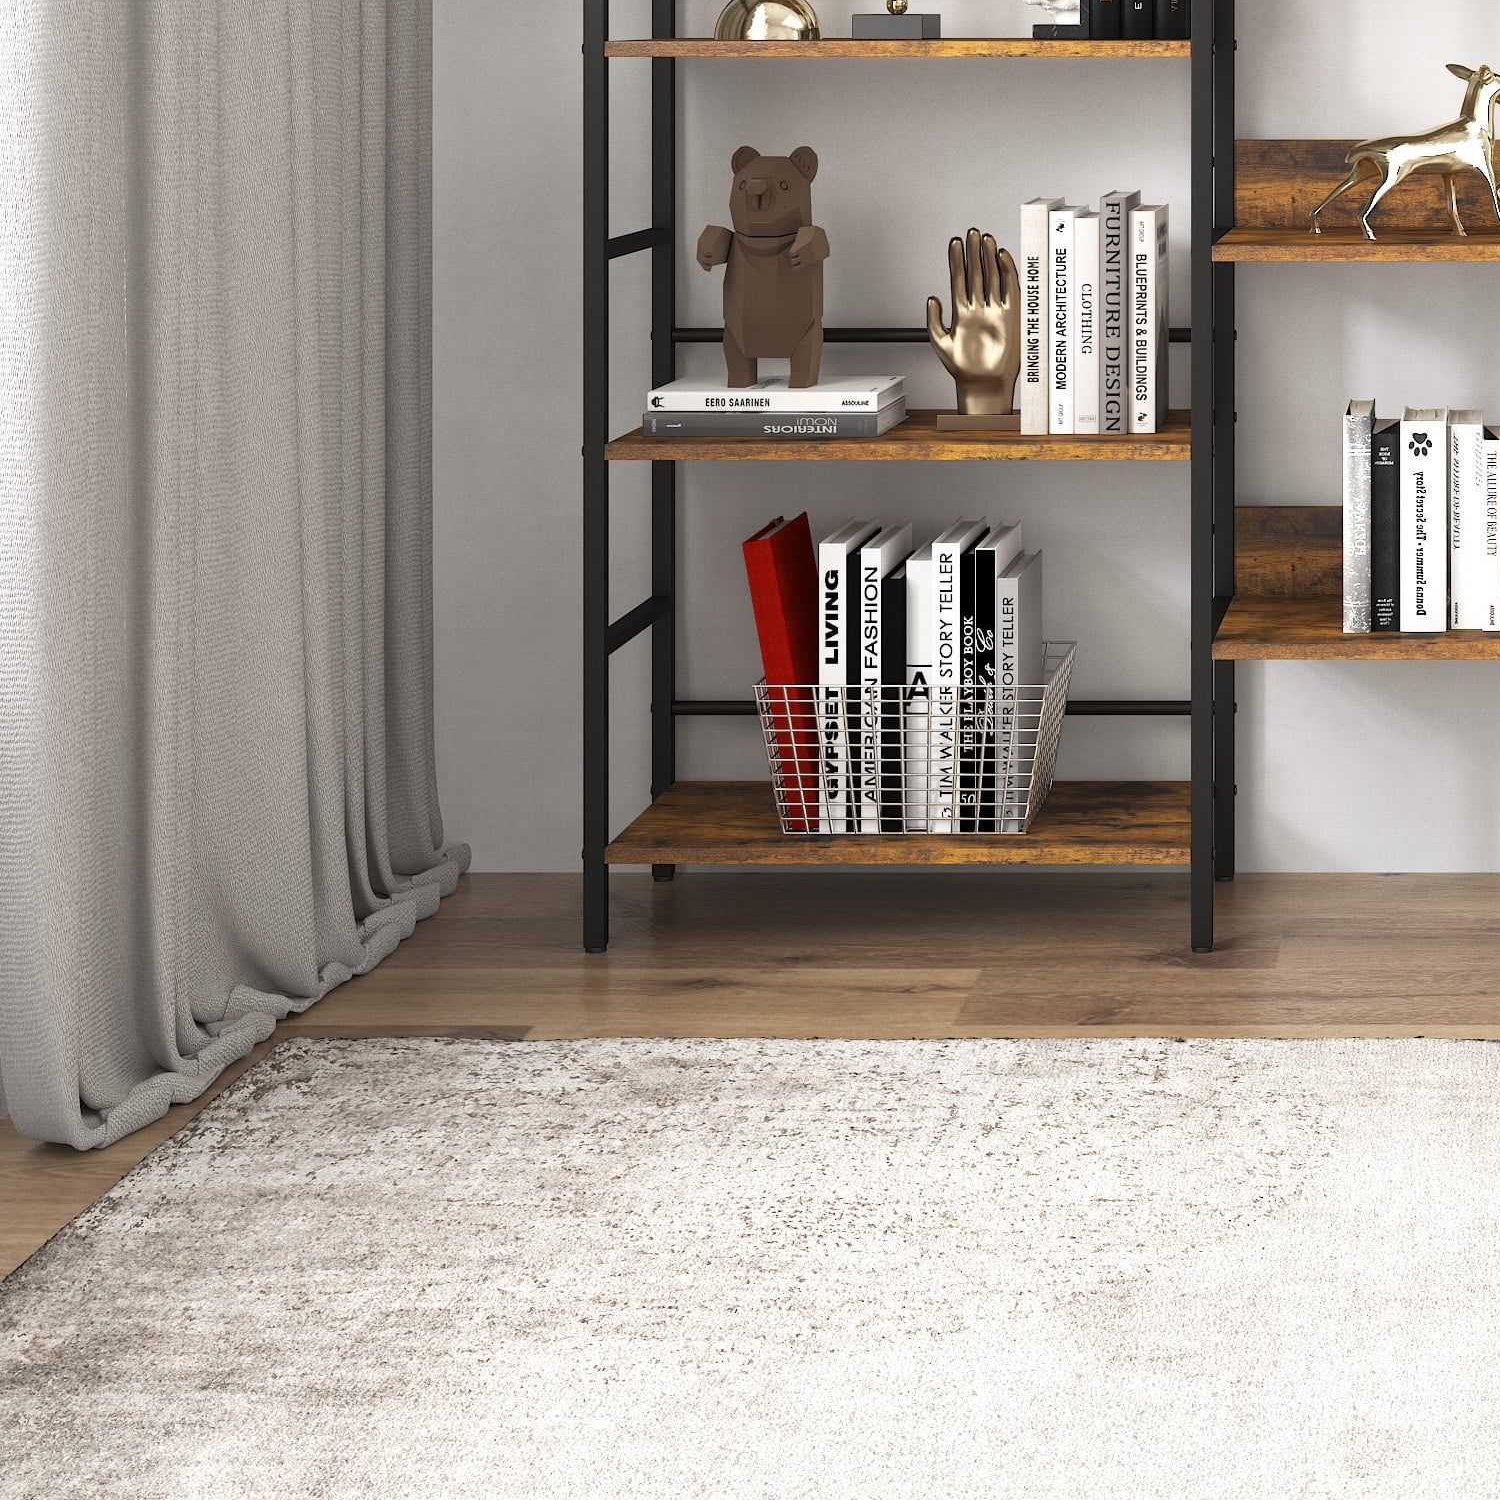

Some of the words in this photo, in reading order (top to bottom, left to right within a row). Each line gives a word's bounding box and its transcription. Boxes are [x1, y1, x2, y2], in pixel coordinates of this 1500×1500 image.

[1027, 256, 1039, 282] HOME
[1056, 249, 1066, 337] ARCHITECTURE
[1106, 202, 1120, 338] FURNITURE
[1136, 254, 1147, 324] BLUEPRINTS
[1027, 285, 1039, 315] HOUSE
[1027, 318, 1039, 335] THE
[1082, 284, 1092, 354] CLOTHING
[1027, 339, 1039, 382] BRINGING
[1056, 341, 1066, 389] MODERN
[1106, 346, 1120, 432] DESIGN
[1136, 340, 1147, 400] BUILDINGS
[705, 398, 726, 407] EERO
[729, 398, 770, 407] SAARINEN
[763, 426, 837, 434] INTERIORS
[796, 418, 837, 426] NOW!
[940, 552, 952, 613] TELLER
[825, 569, 839, 664] LIVING
[864, 566, 878, 668] FASHION
[964, 615, 974, 654] BOOK
[1003, 597, 1014, 648] TELLER
[940, 620, 952, 678] STORY
[1003, 652, 1014, 700] STORY
[825, 686, 839, 800] GYPSET
[864, 678, 878, 802] AMERCAN
[940, 685, 952, 760] WALKER
[940, 766, 952, 798] TIM
